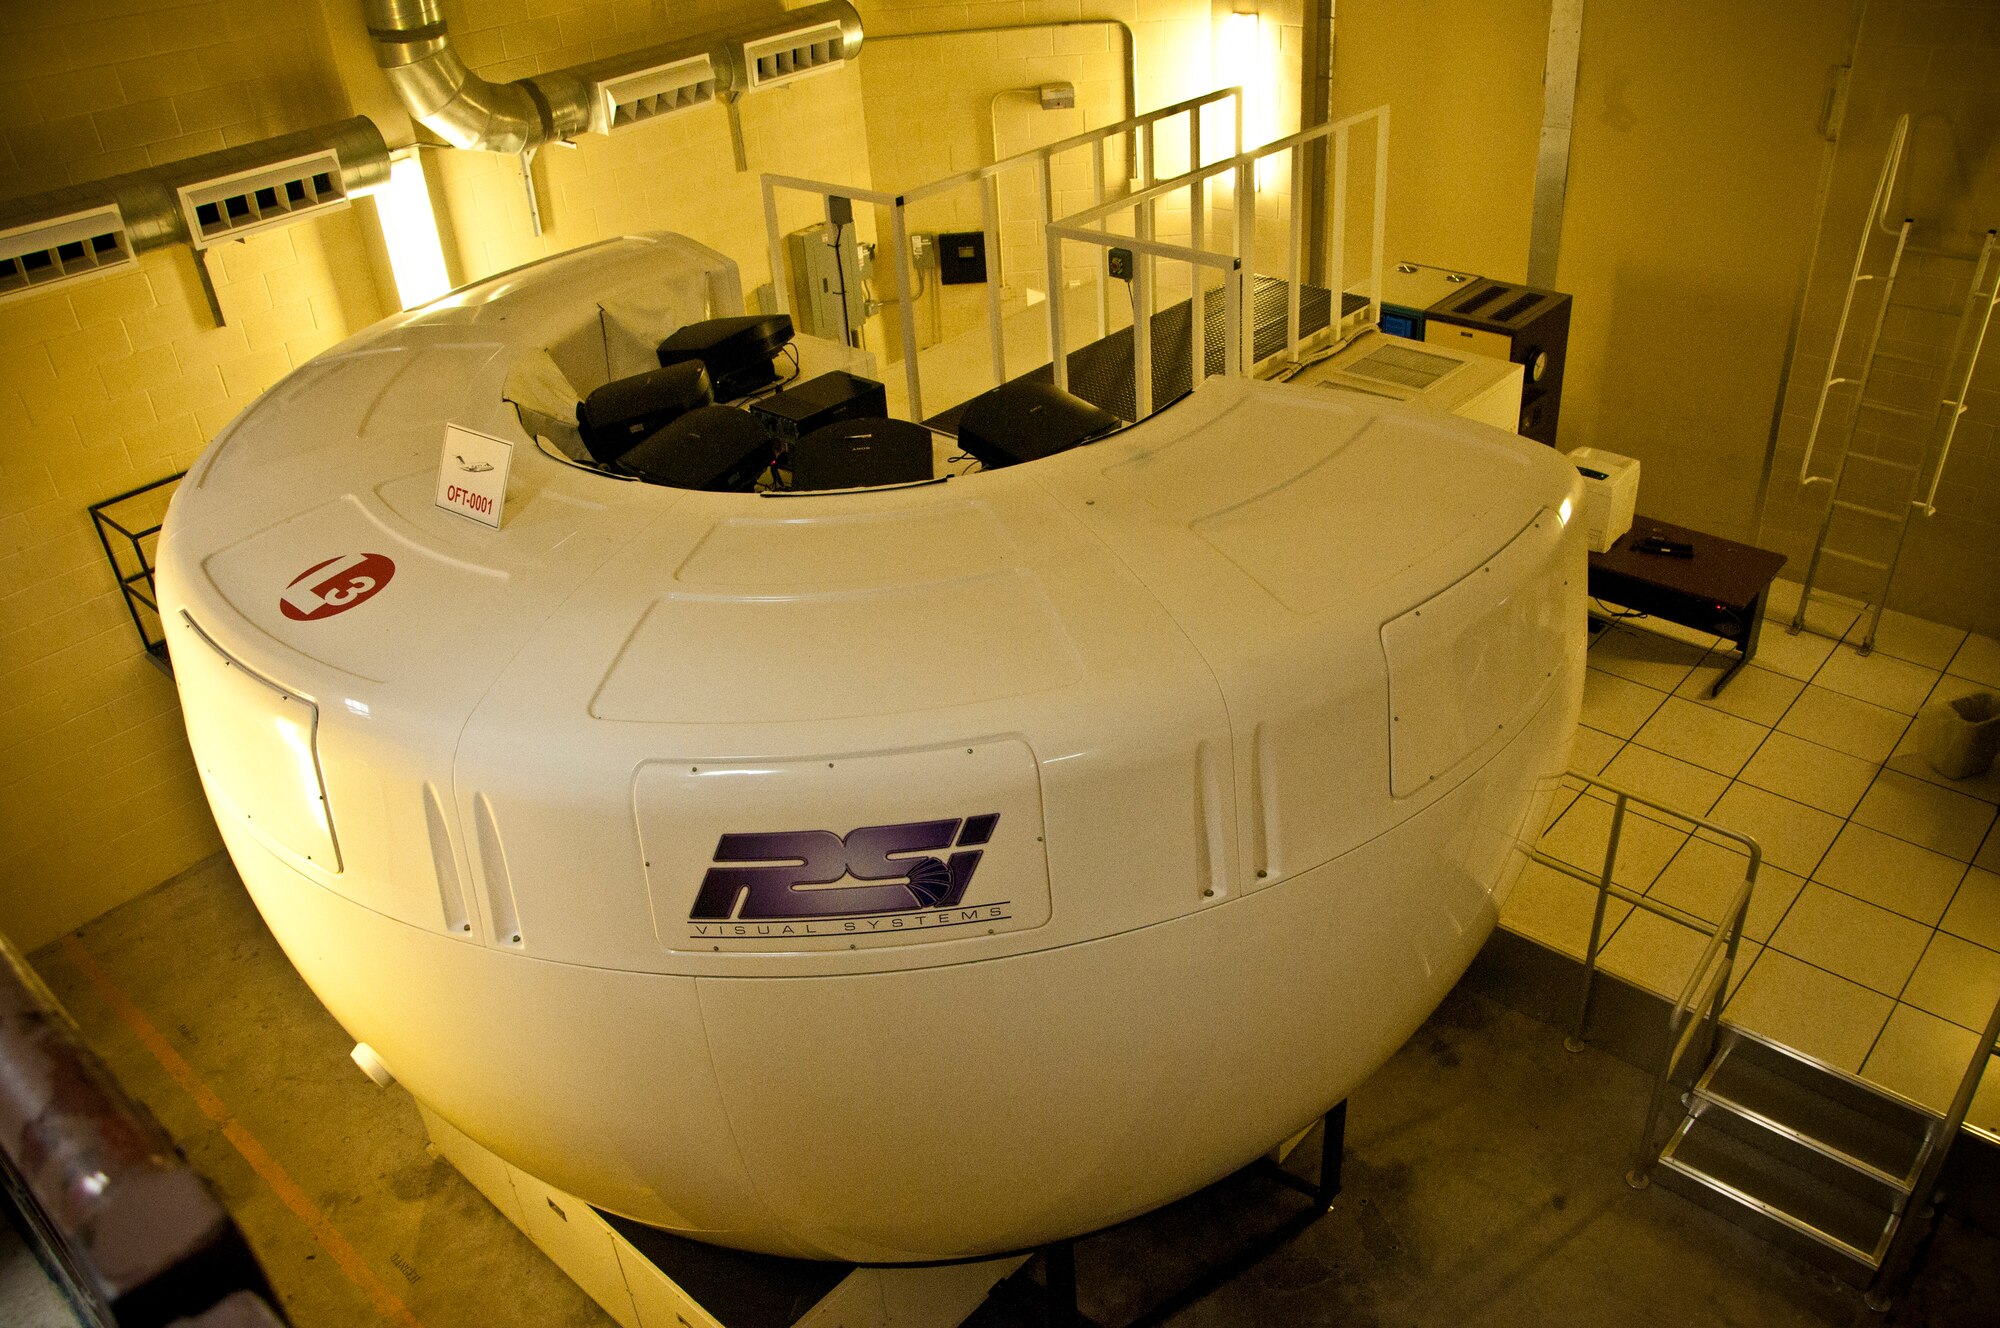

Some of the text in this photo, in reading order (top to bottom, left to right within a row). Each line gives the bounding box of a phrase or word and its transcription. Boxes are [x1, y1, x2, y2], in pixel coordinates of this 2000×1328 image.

[447, 484, 493, 515] OFT-0001
[696, 906, 1003, 936] VISUAL SYSTEMS
